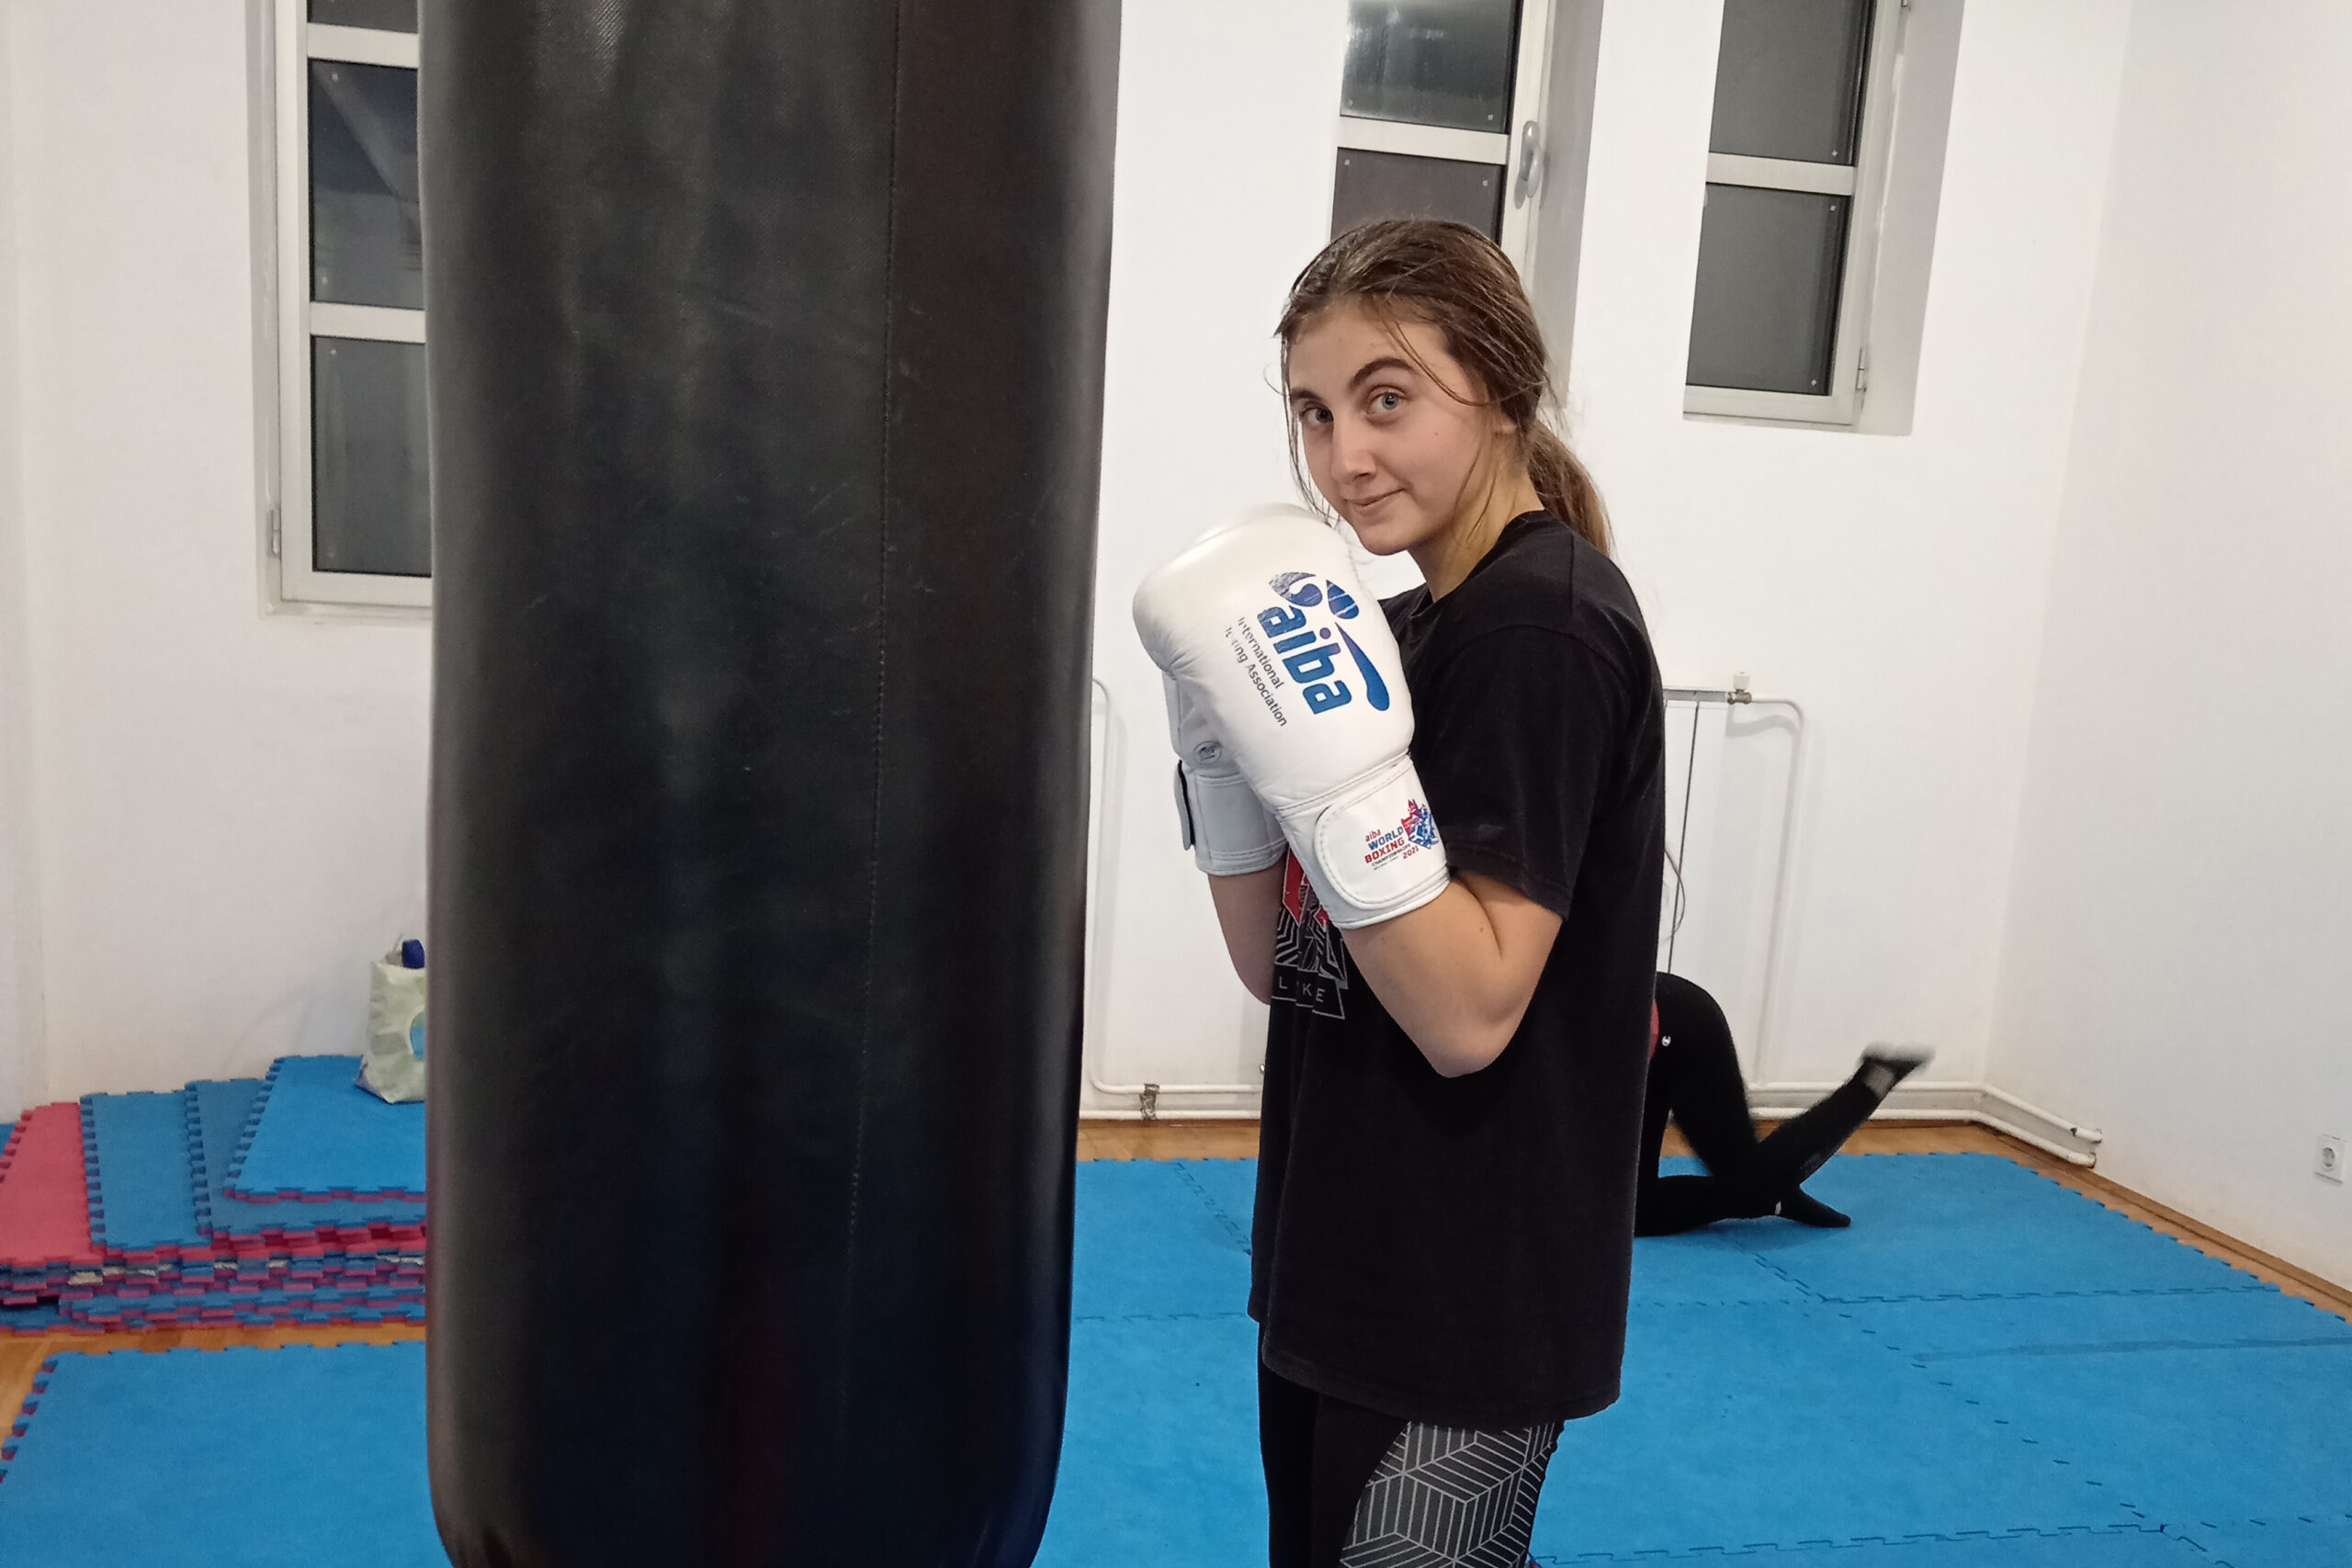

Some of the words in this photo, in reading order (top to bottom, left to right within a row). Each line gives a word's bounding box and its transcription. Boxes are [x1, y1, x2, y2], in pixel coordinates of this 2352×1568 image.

[1257, 604, 1352, 715] aiba
[1225, 626, 1249, 663] ing
[1244, 663, 1288, 727] Association
[1365, 829, 1382, 842] aiba
[1368, 826, 1404, 851] WORLD
[1364, 837, 1405, 863] BOXING
[1402, 845, 1419, 860] 2021
